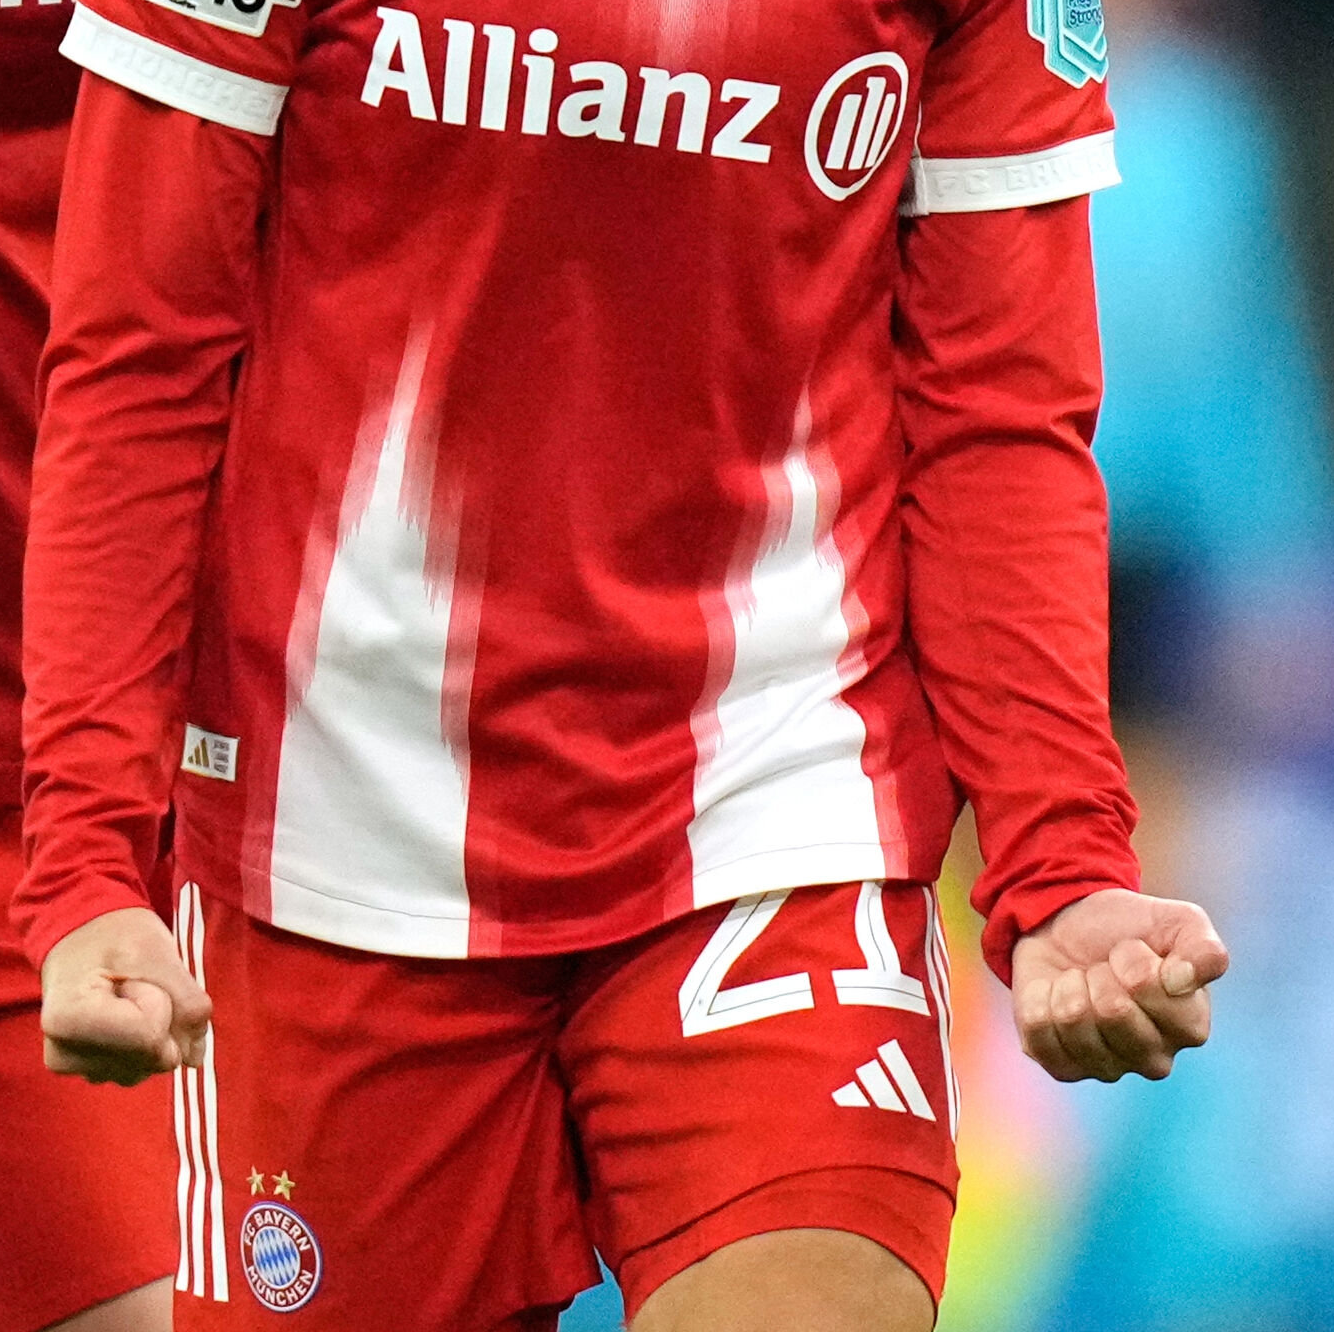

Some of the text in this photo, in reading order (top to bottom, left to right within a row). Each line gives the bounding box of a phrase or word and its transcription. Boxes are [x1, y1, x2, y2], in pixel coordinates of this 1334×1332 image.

[360, 6, 781, 163] Allianz
[678, 881, 931, 1037] 21
[243, 1210, 311, 1251] FC BAYERN
[247, 1266, 313, 1305] MÜNCHEN
